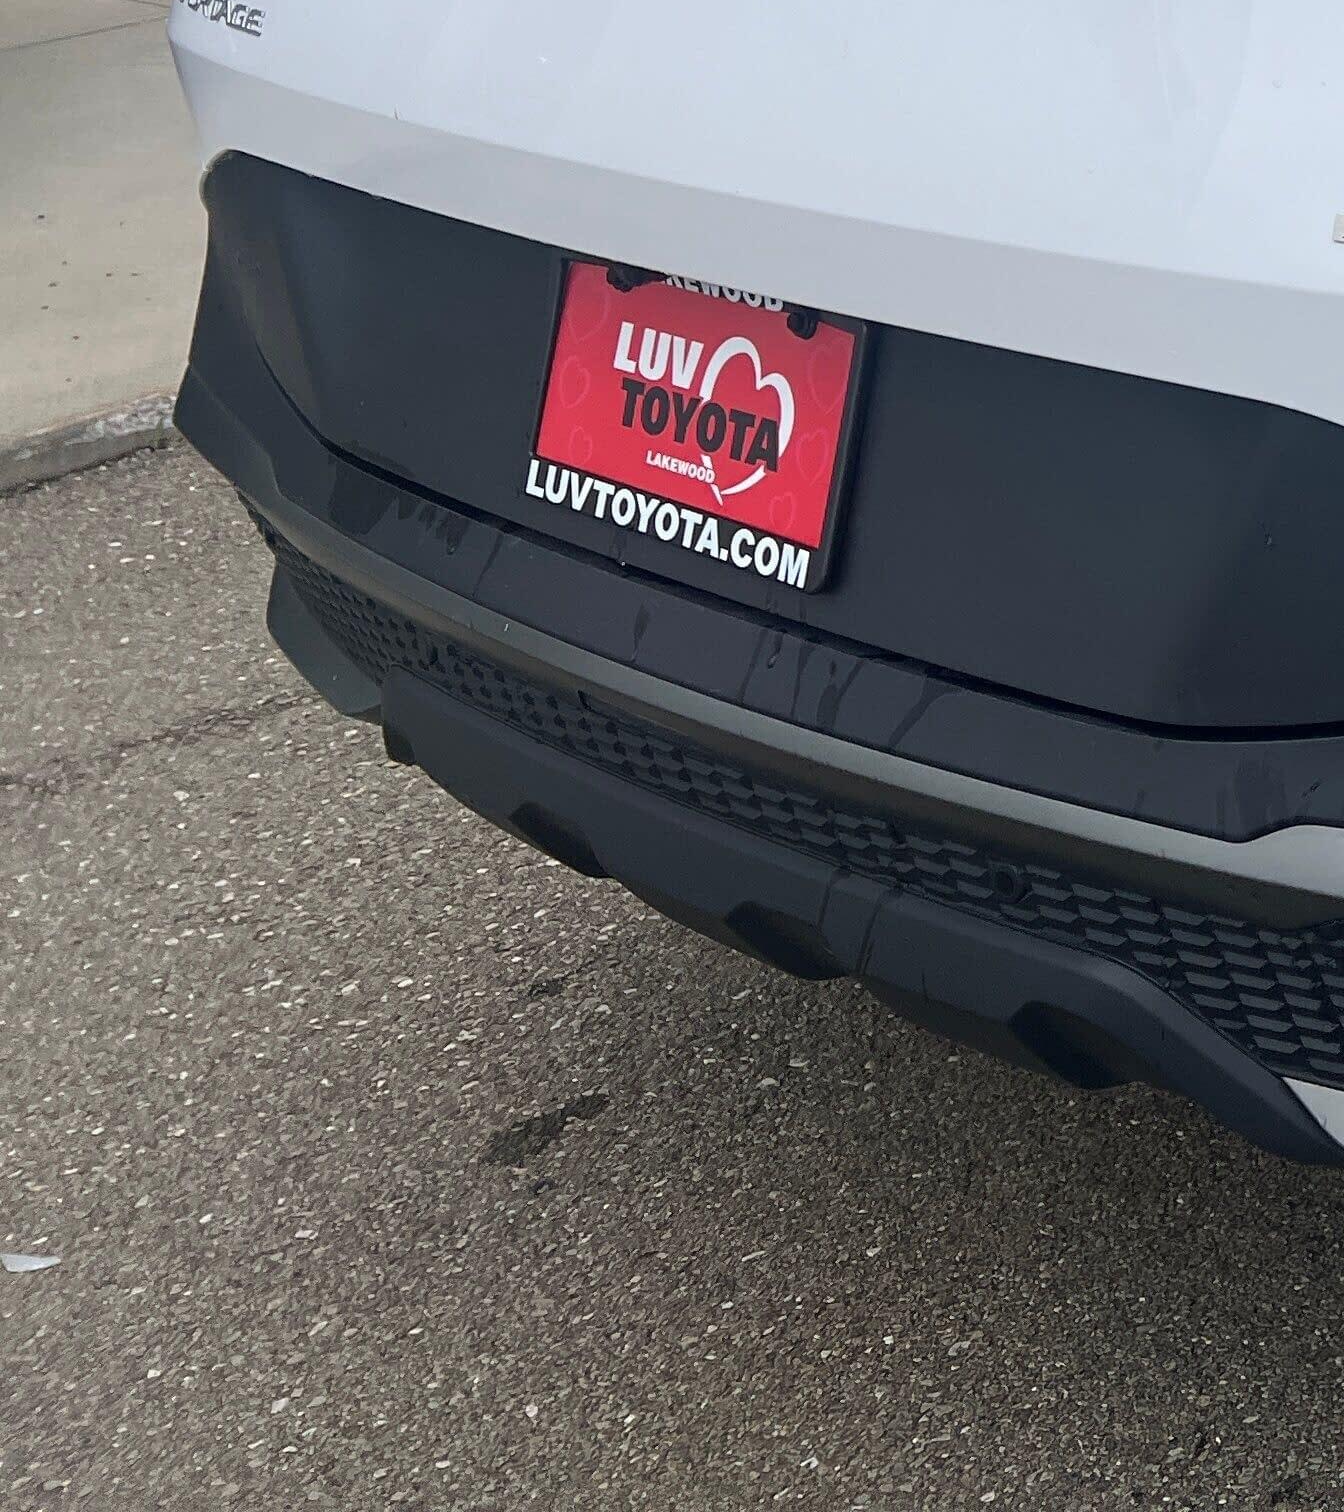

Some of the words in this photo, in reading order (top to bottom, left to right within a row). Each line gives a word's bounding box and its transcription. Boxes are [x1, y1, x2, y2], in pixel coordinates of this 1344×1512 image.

[613, 321, 704, 390] LUV
[620, 377, 781, 472] TOYOTA
[646, 450, 716, 484] LAKEWOOD
[525, 459, 811, 589] LUVTOYOTA.COM
